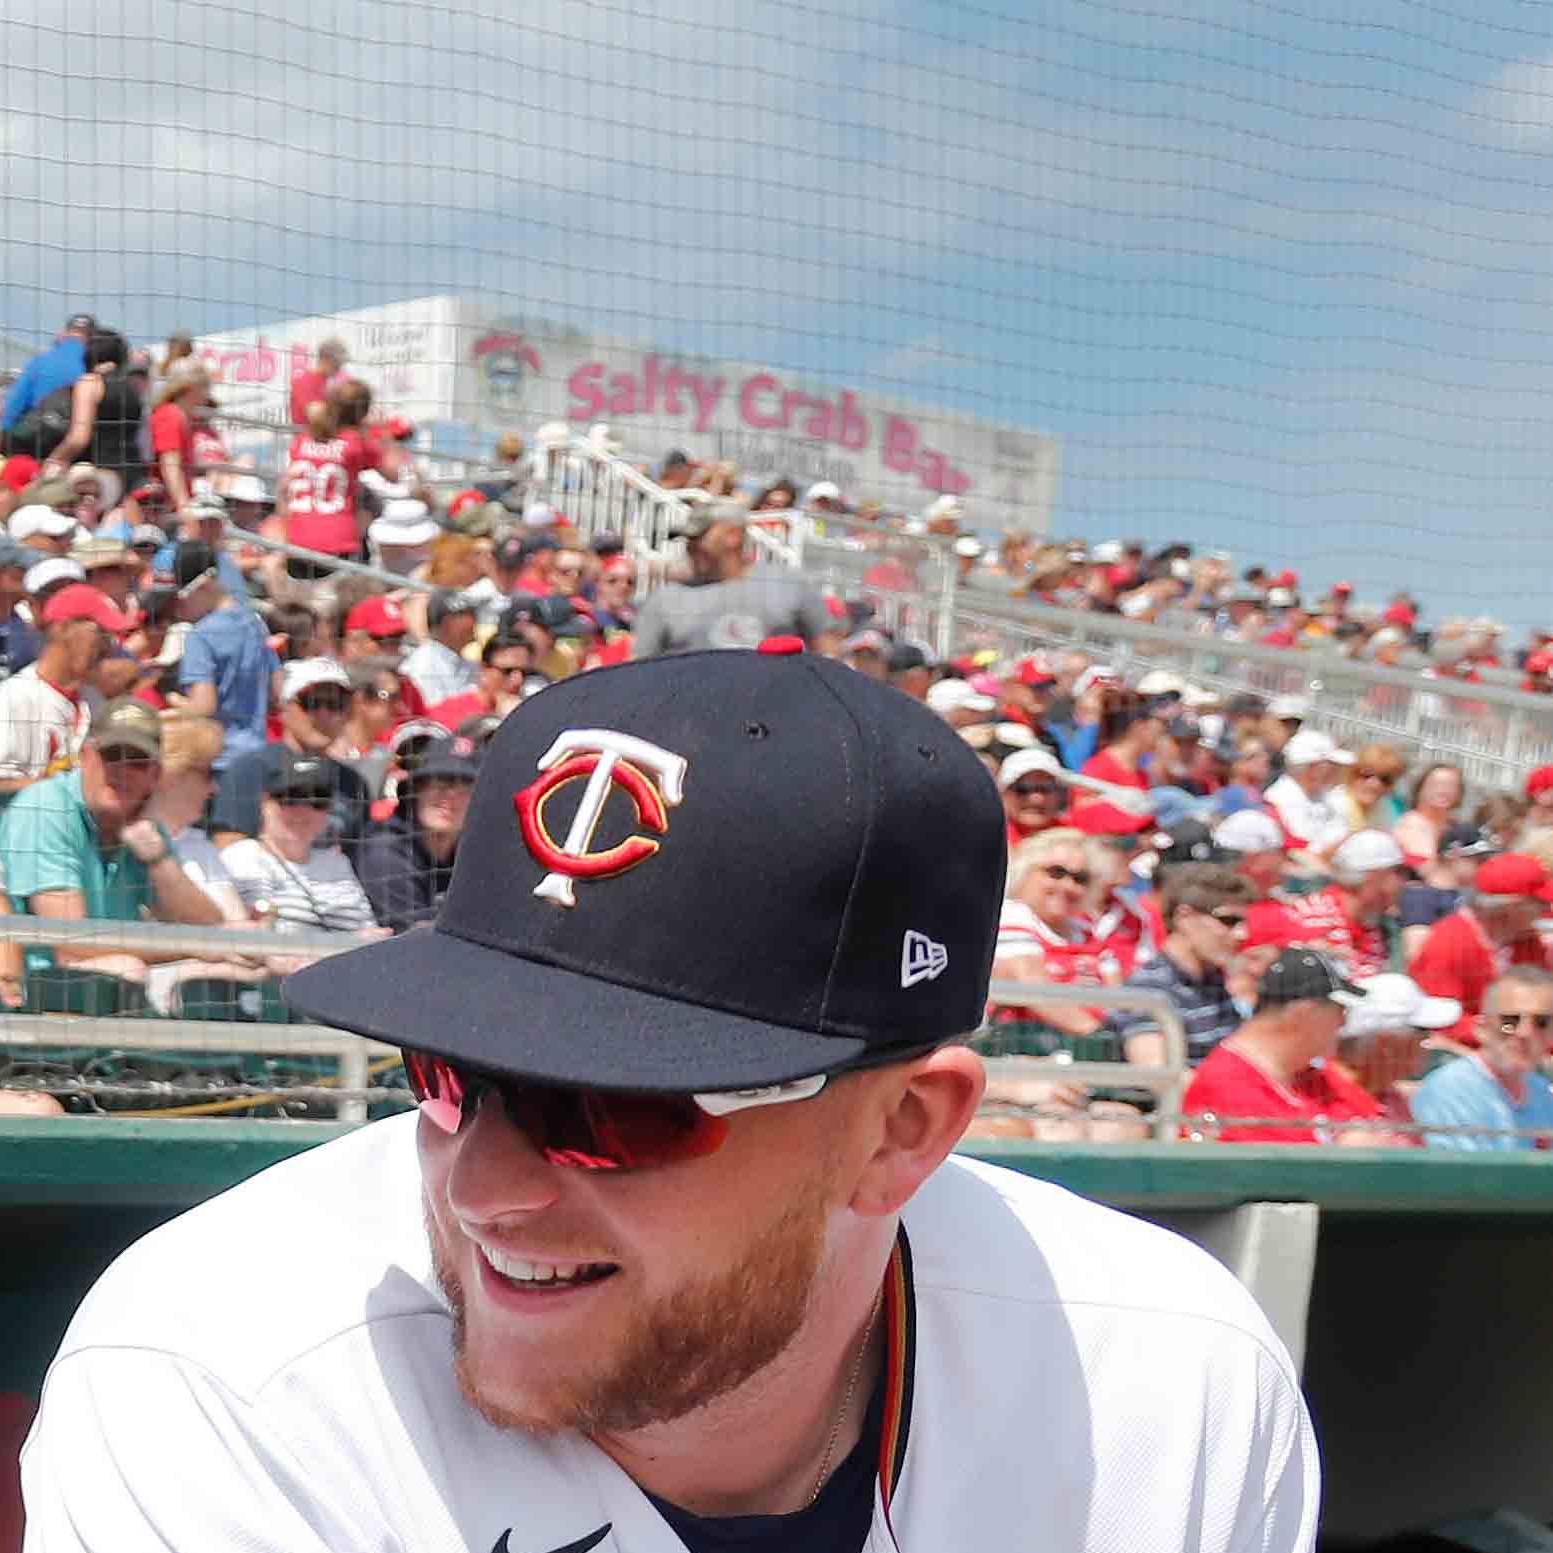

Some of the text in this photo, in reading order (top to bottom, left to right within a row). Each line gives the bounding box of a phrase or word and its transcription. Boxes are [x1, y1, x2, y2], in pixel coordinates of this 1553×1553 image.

[567, 353, 723, 433] Salty
[740, 373, 871, 452] Crab
[882, 416, 973, 494] Bar
[287, 459, 350, 514] 20
